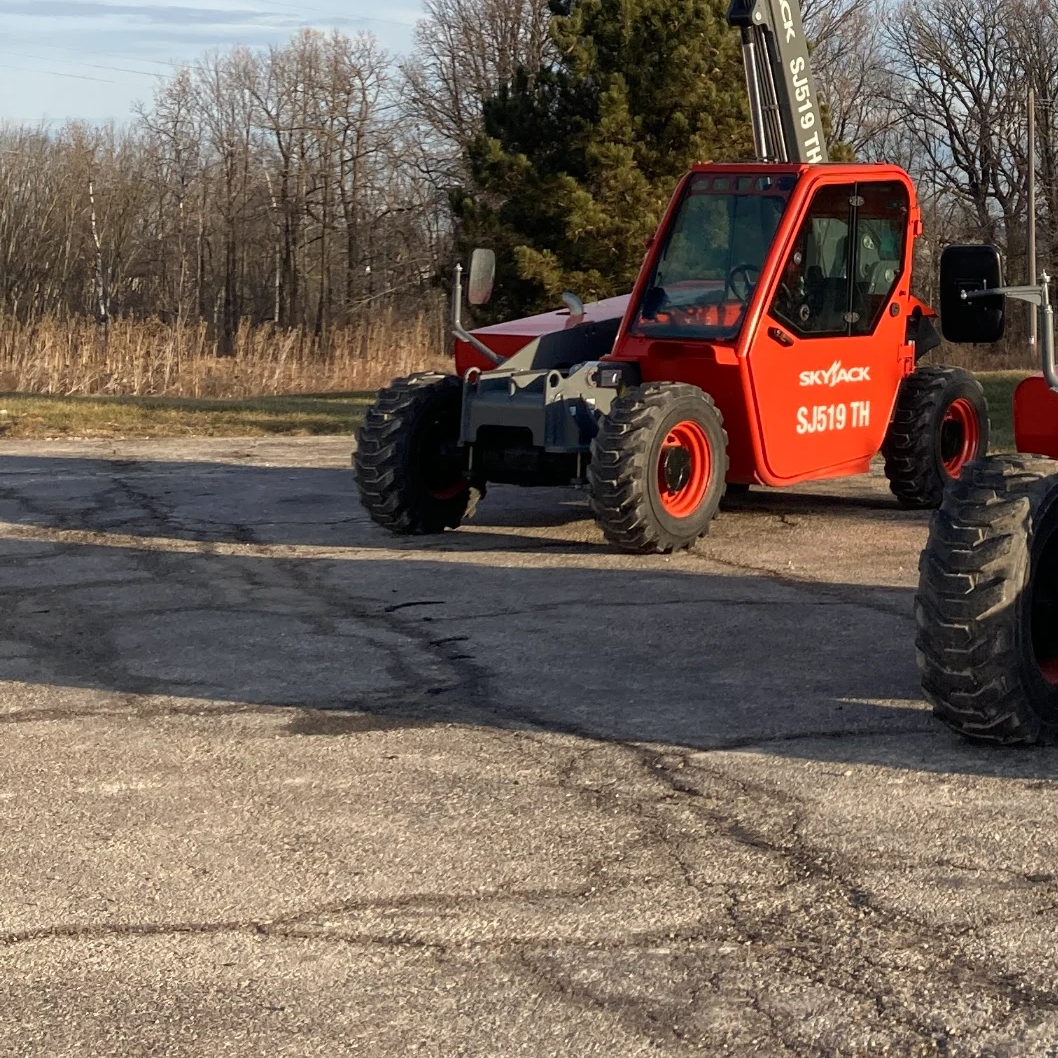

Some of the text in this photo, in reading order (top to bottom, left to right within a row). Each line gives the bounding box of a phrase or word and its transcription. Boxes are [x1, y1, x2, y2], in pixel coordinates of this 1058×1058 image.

[790, 56, 822, 164] SJ519 TH
[799, 360, 871, 387] SKYJACK
[796, 400, 870, 435] SJ519 TH
